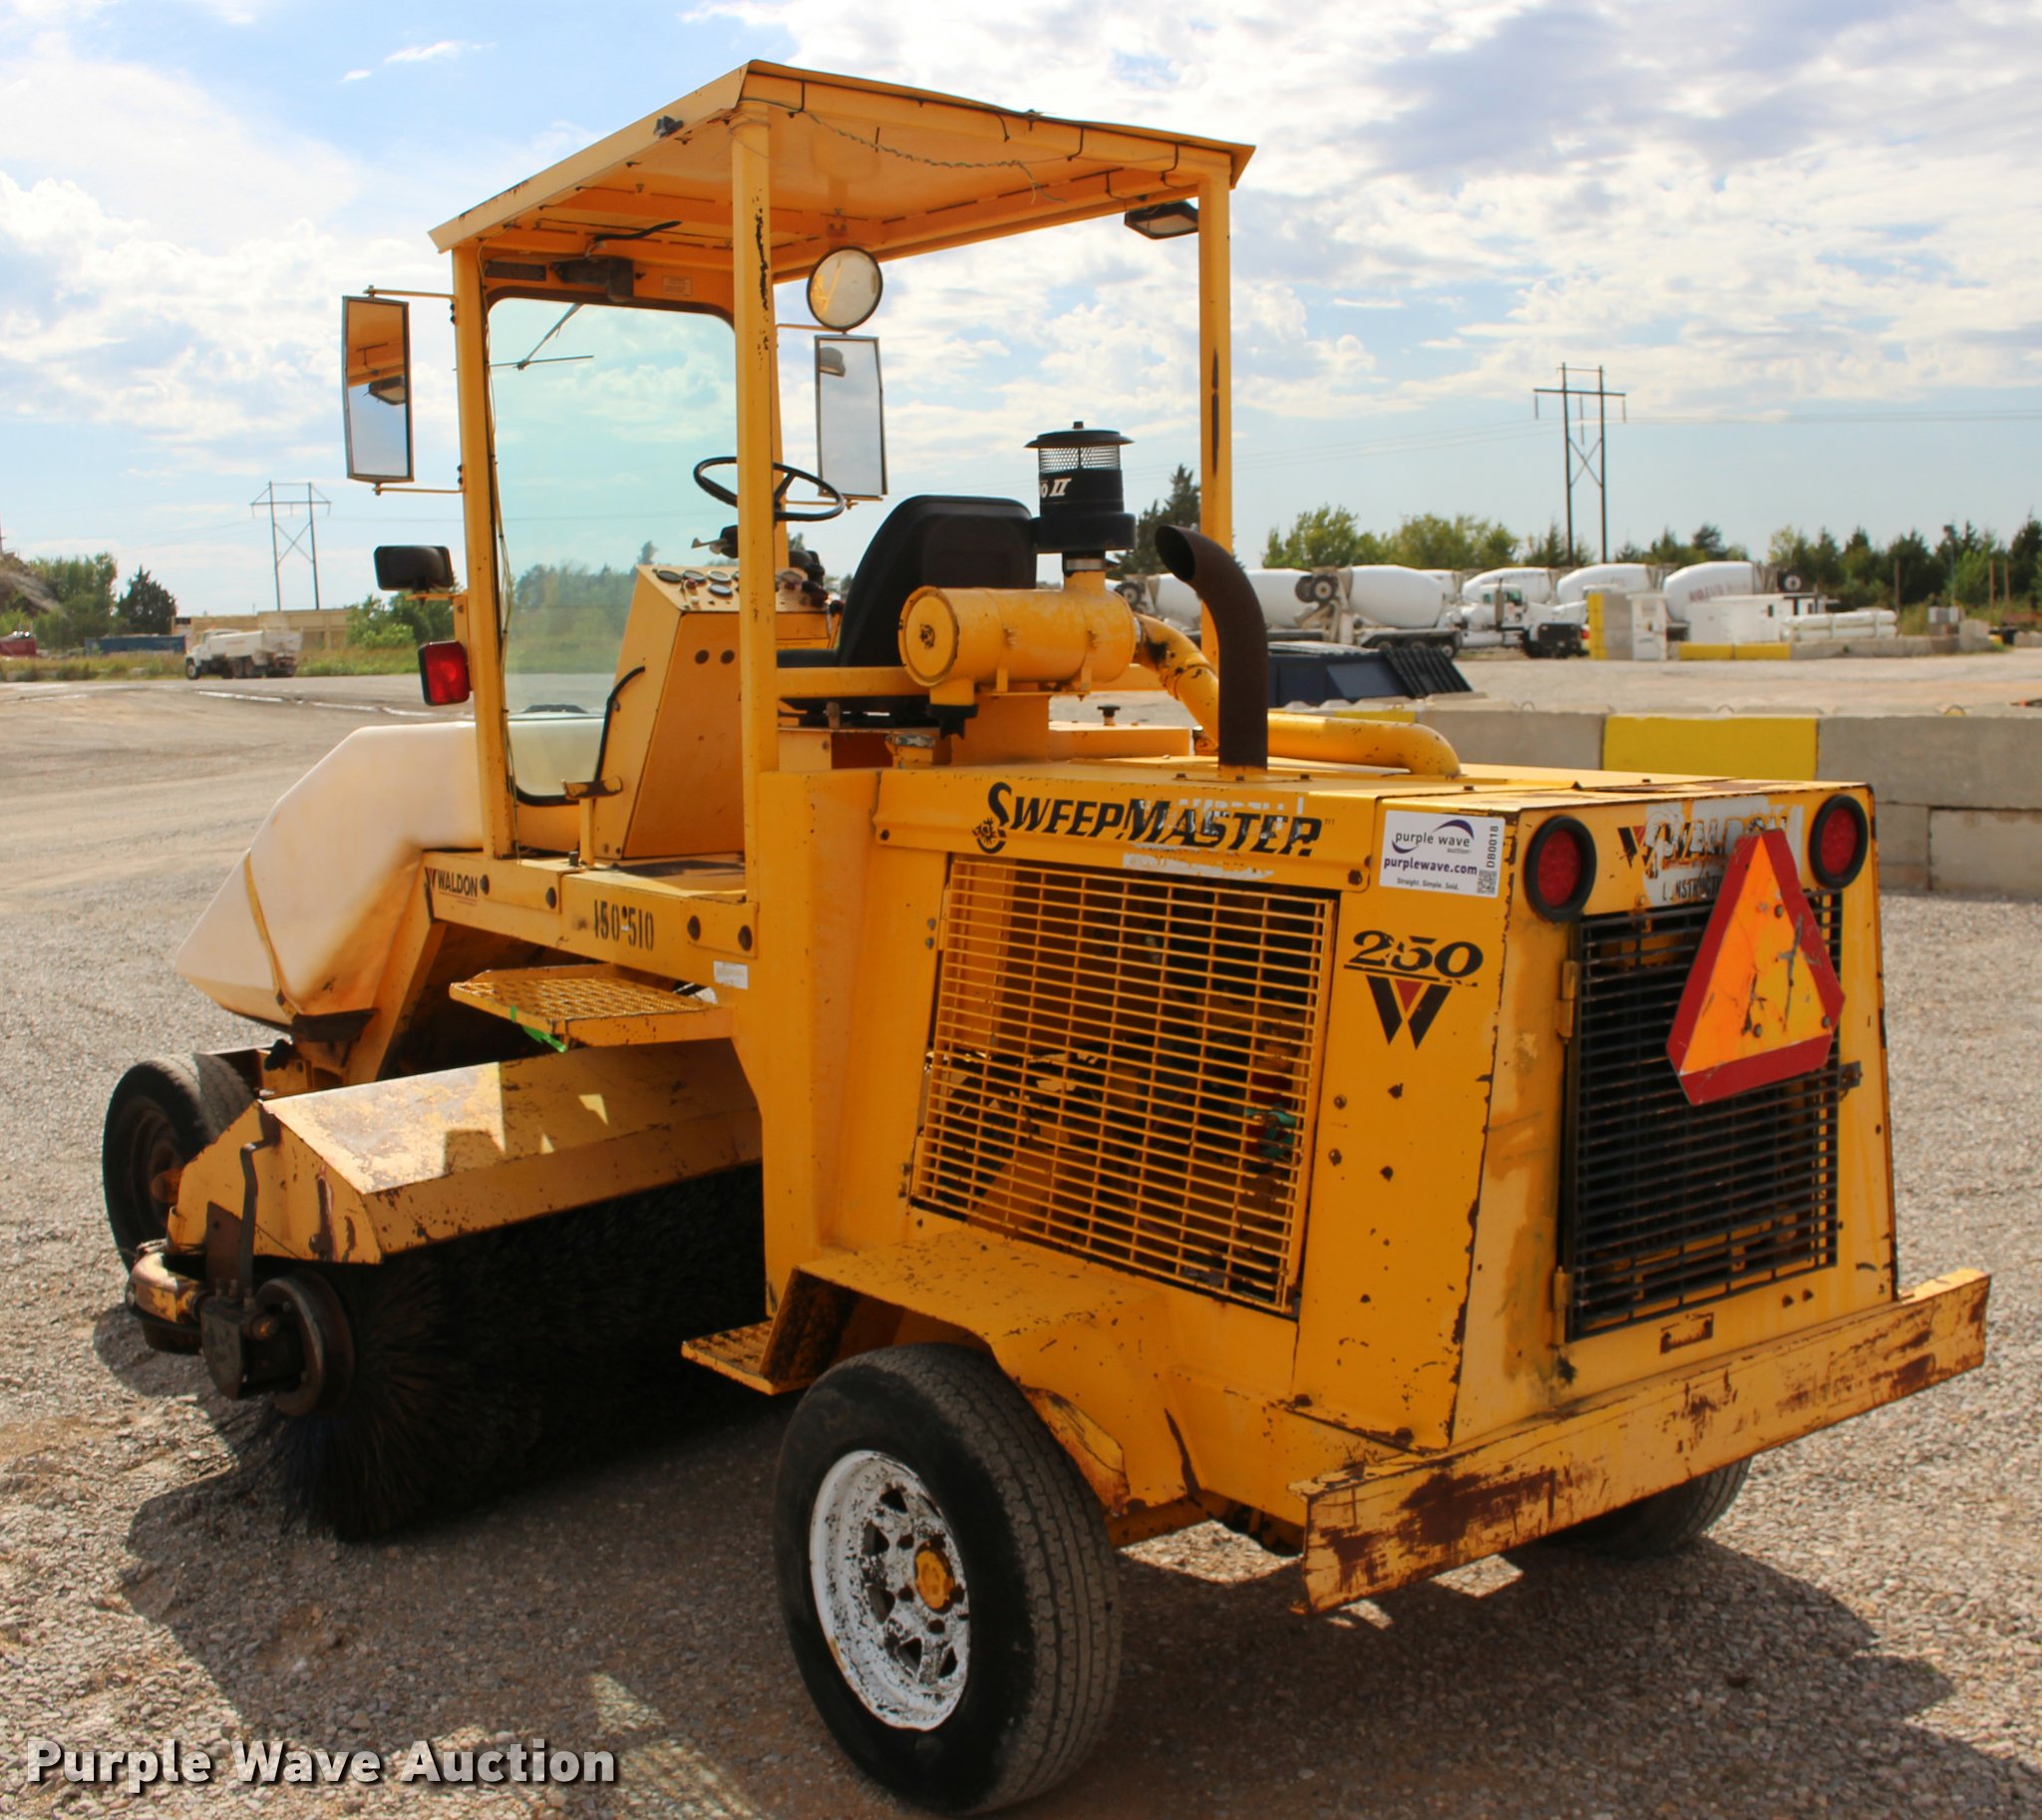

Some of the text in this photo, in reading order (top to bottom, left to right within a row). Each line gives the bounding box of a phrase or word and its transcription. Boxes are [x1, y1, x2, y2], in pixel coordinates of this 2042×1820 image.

[1396, 832, 1471, 847] purple wave
[1384, 857, 1478, 876] purplewave.com
[437, 869, 479, 898] WALDON
[1349, 929, 1485, 978] 250
